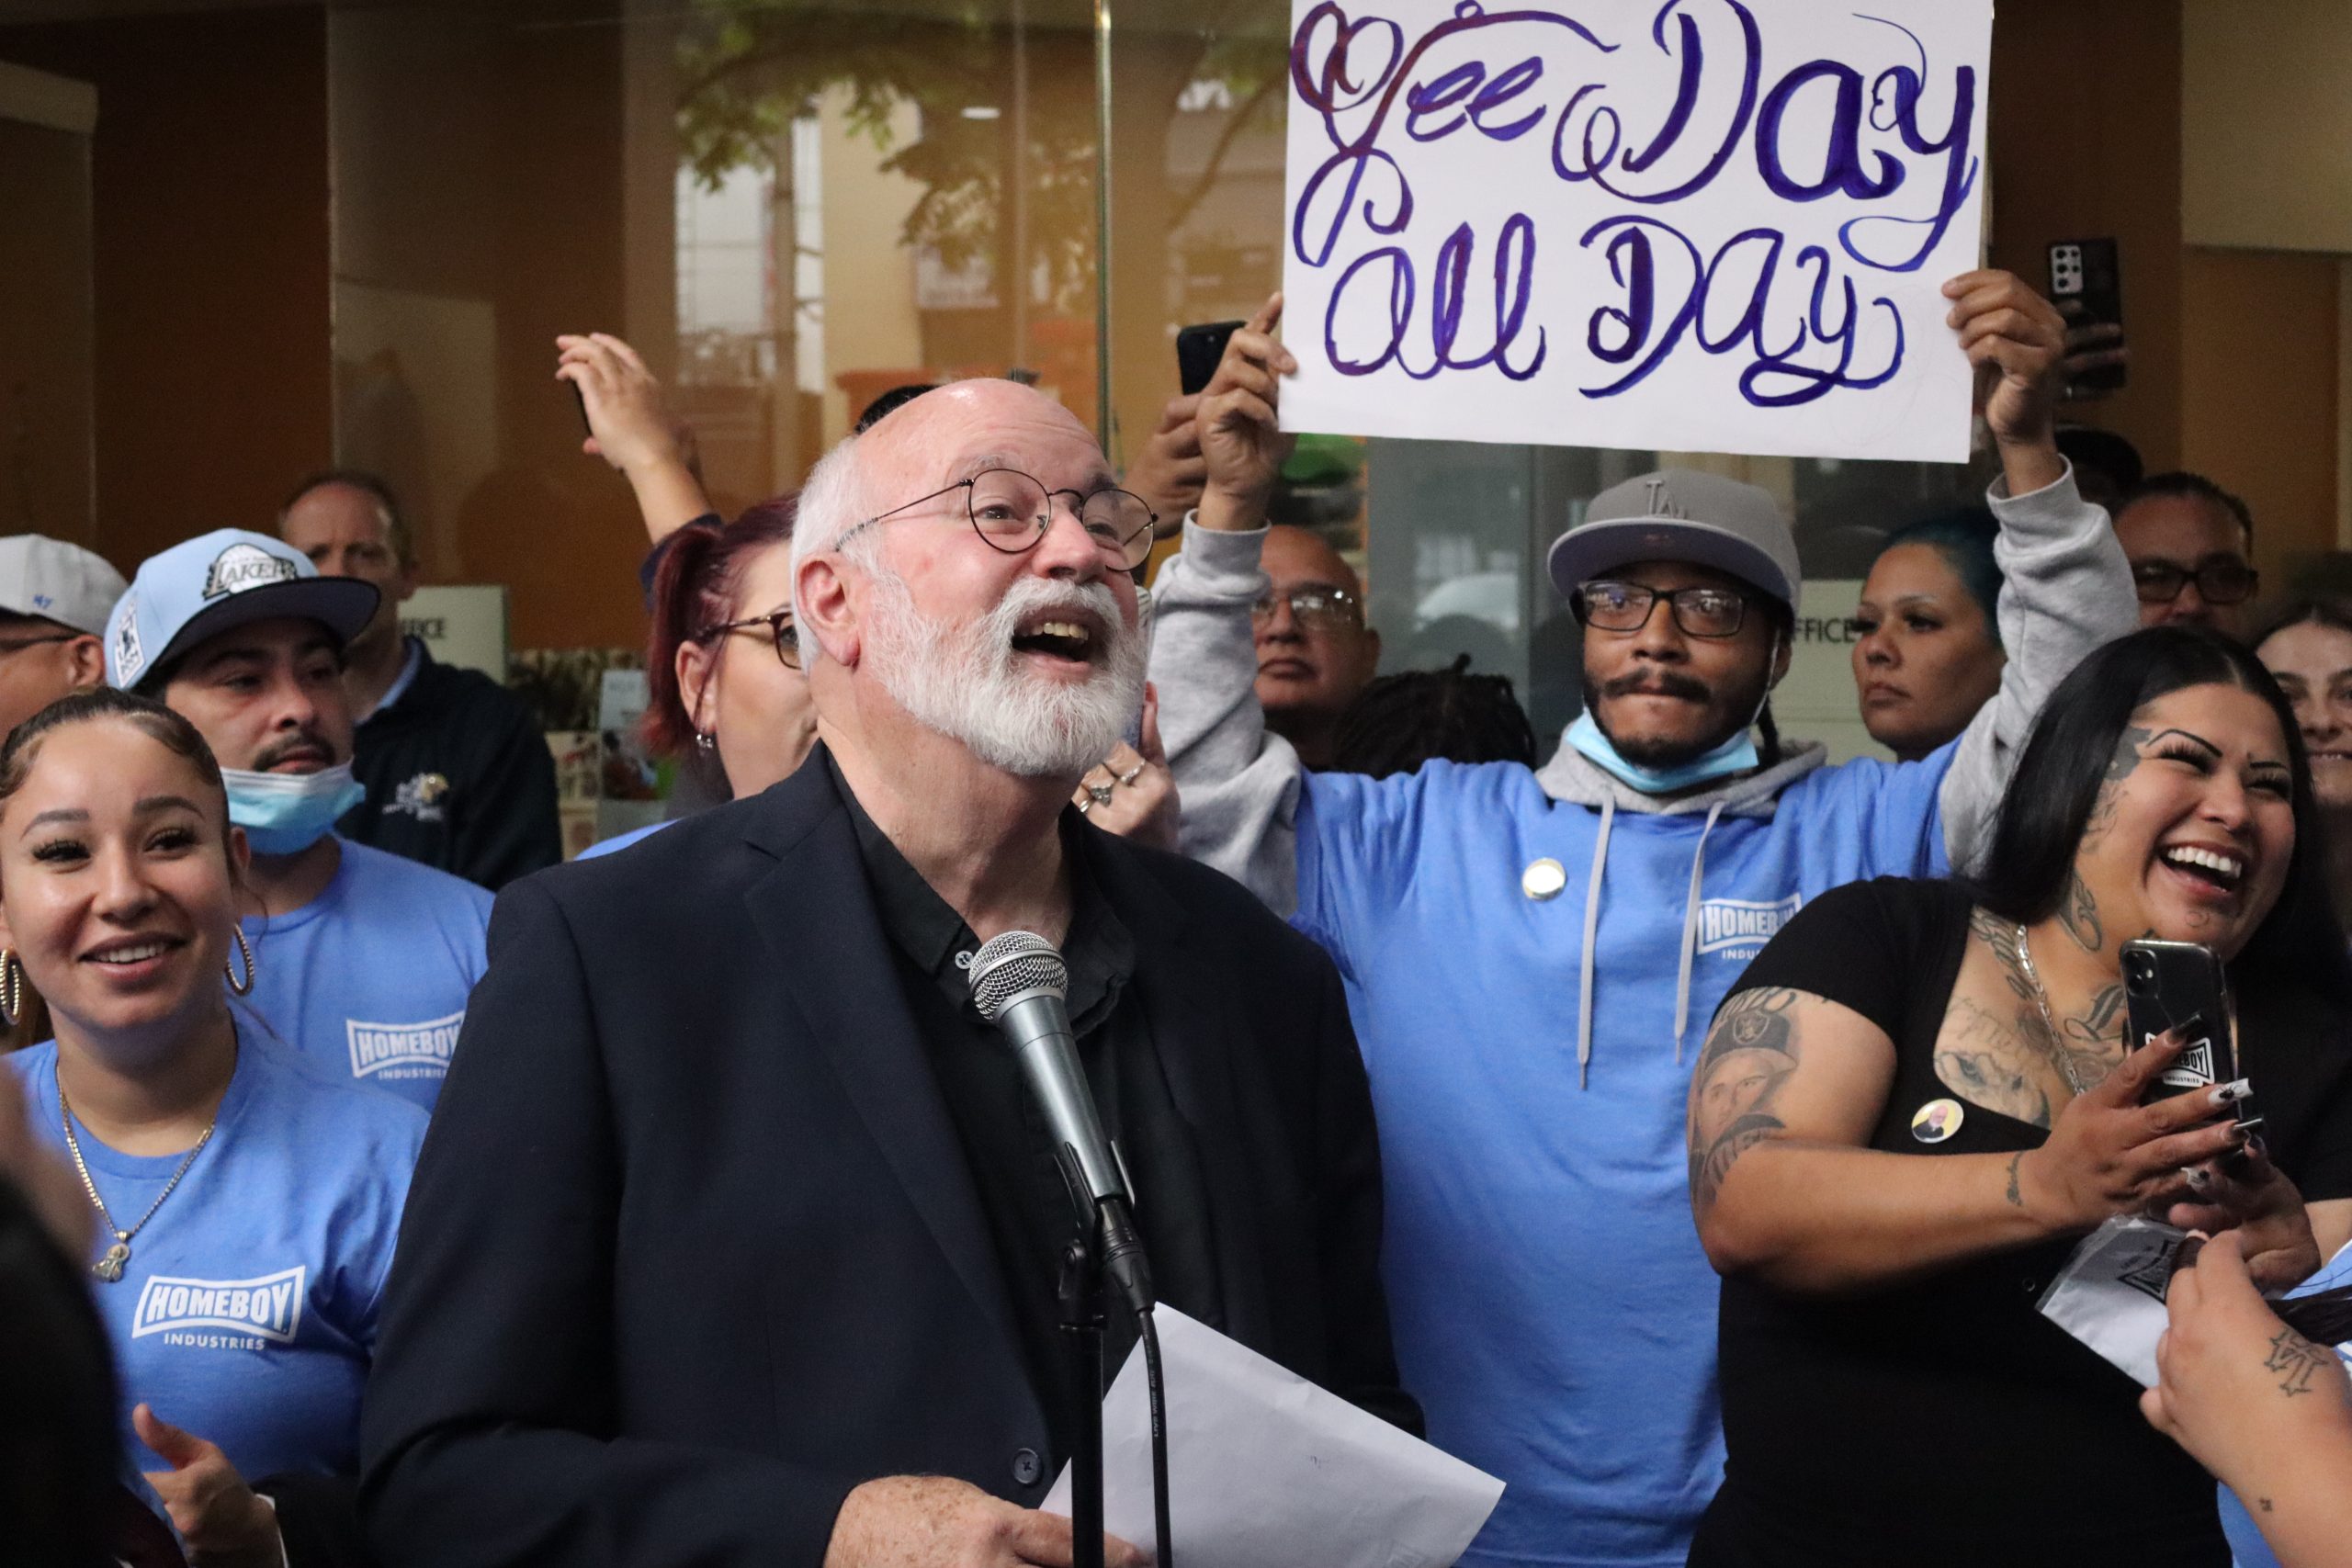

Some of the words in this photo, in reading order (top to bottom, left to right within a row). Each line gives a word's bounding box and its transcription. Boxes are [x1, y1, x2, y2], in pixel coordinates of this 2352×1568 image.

[1552, 0, 1978, 272] Day
[1578, 214, 1905, 407] Day
[146, 1281, 293, 1331] HOMEBOY
[164, 1332, 266, 1350] INDUSTRIES
